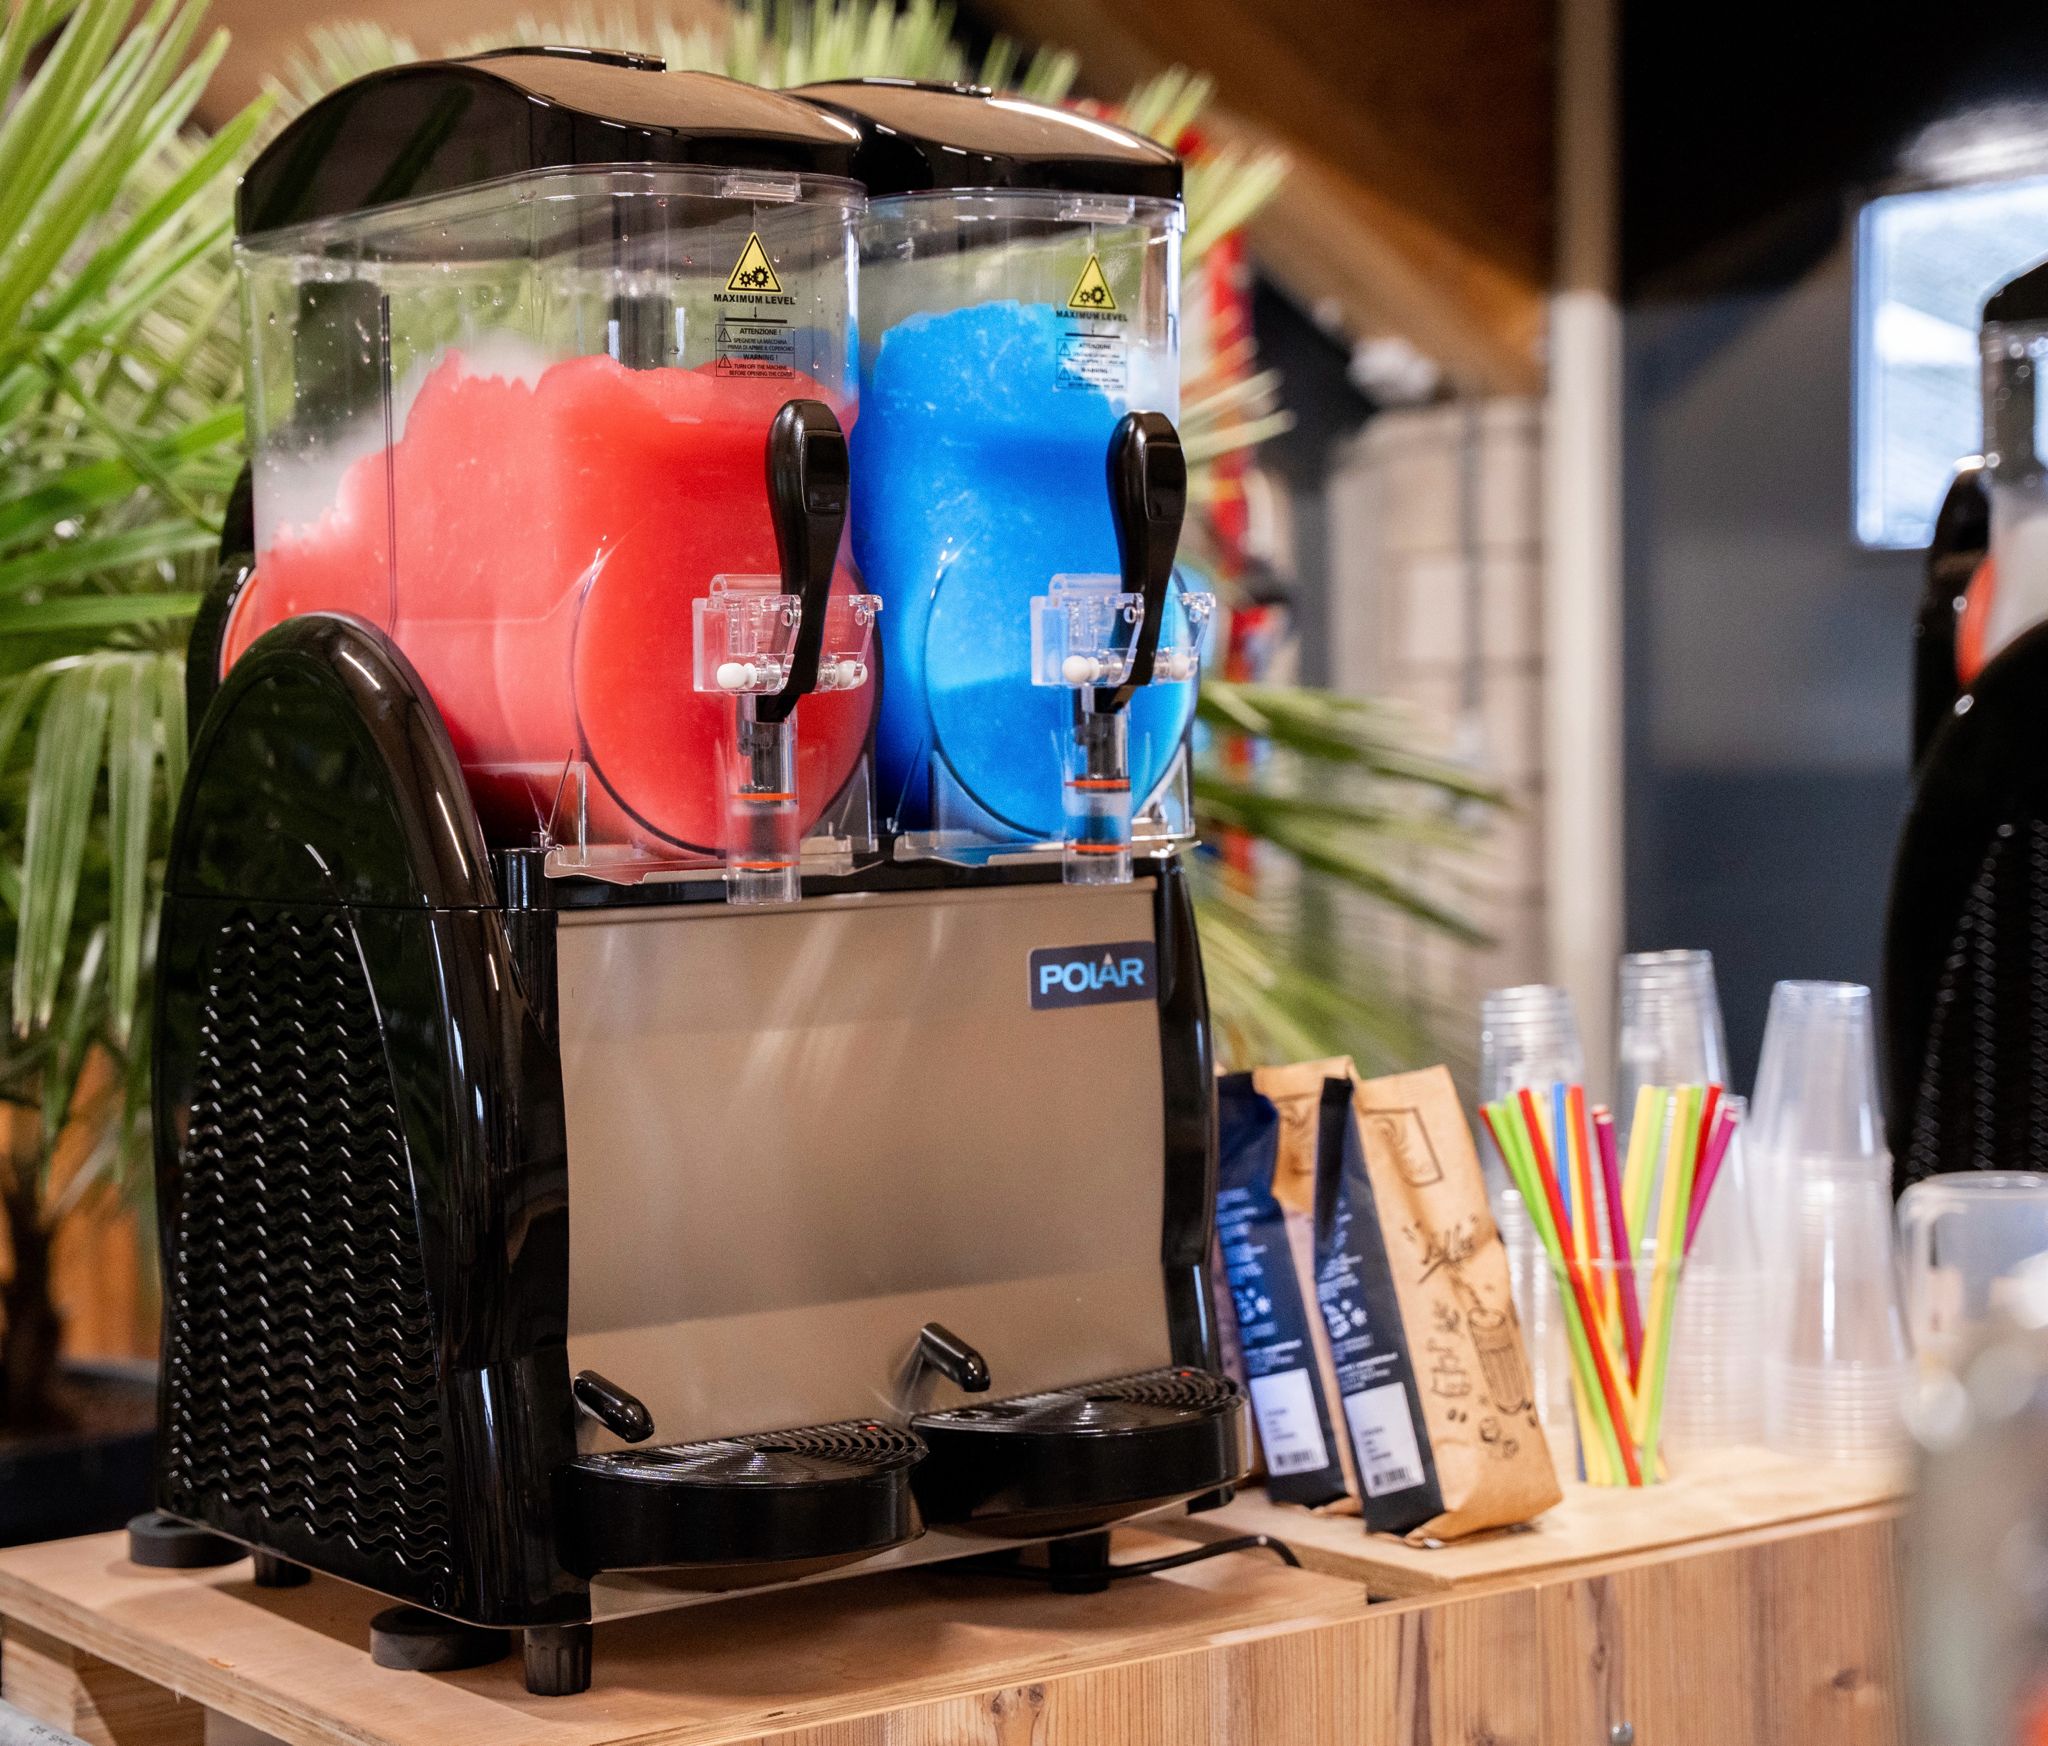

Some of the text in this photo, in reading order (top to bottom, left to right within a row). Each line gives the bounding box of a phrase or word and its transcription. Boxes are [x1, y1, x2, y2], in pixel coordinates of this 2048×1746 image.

[714, 294, 796, 304] MAXIMUM LEVEL
[1056, 311, 1128, 322] MAXIMUM LEVEL
[1040, 952, 1145, 995] POLAR
